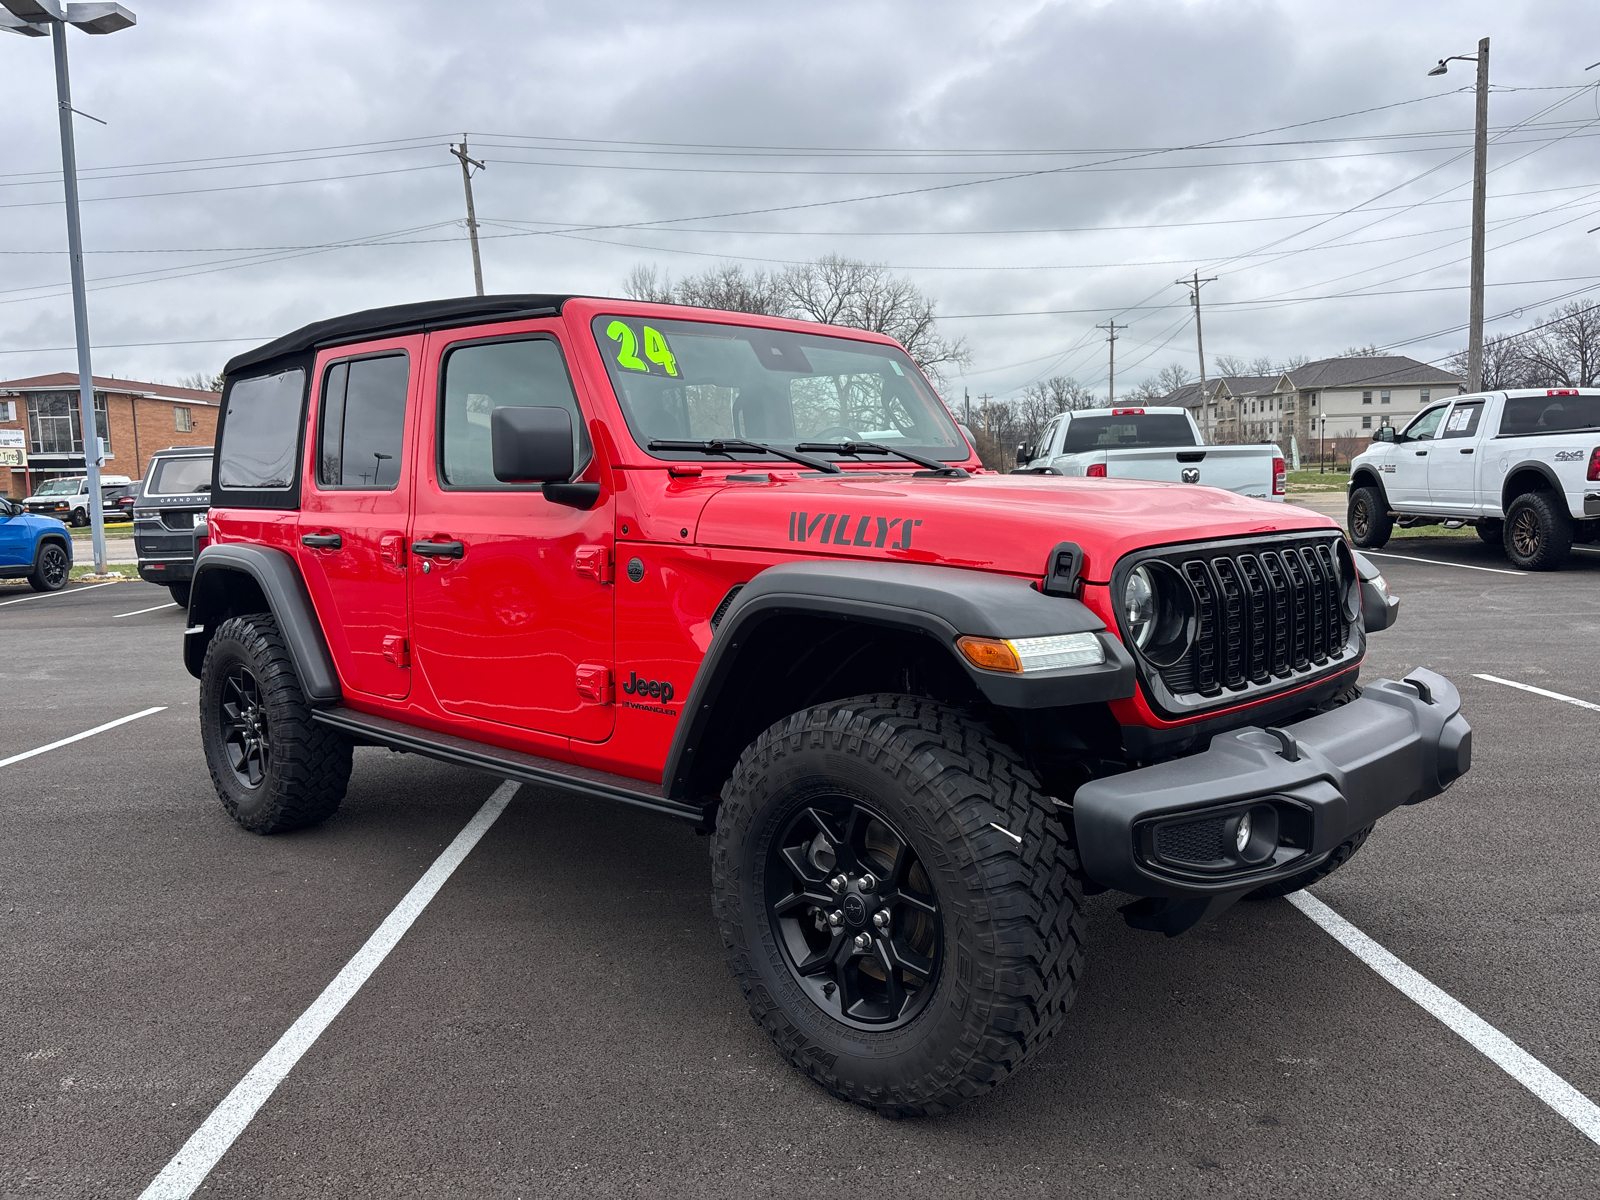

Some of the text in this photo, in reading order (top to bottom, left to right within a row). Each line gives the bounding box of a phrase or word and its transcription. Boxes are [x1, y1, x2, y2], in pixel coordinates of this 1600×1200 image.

[606, 320, 679, 377] 24
[2, 452, 19, 462] Tires
[1554, 450, 1586, 460] 4x4
[788, 511, 923, 550] WILLYS
[622, 670, 675, 704] Jeep
[630, 701, 677, 717] WRANGLER
[900, 798, 973, 1021] FALKEN
[726, 856, 839, 1069] WILDPEAK
